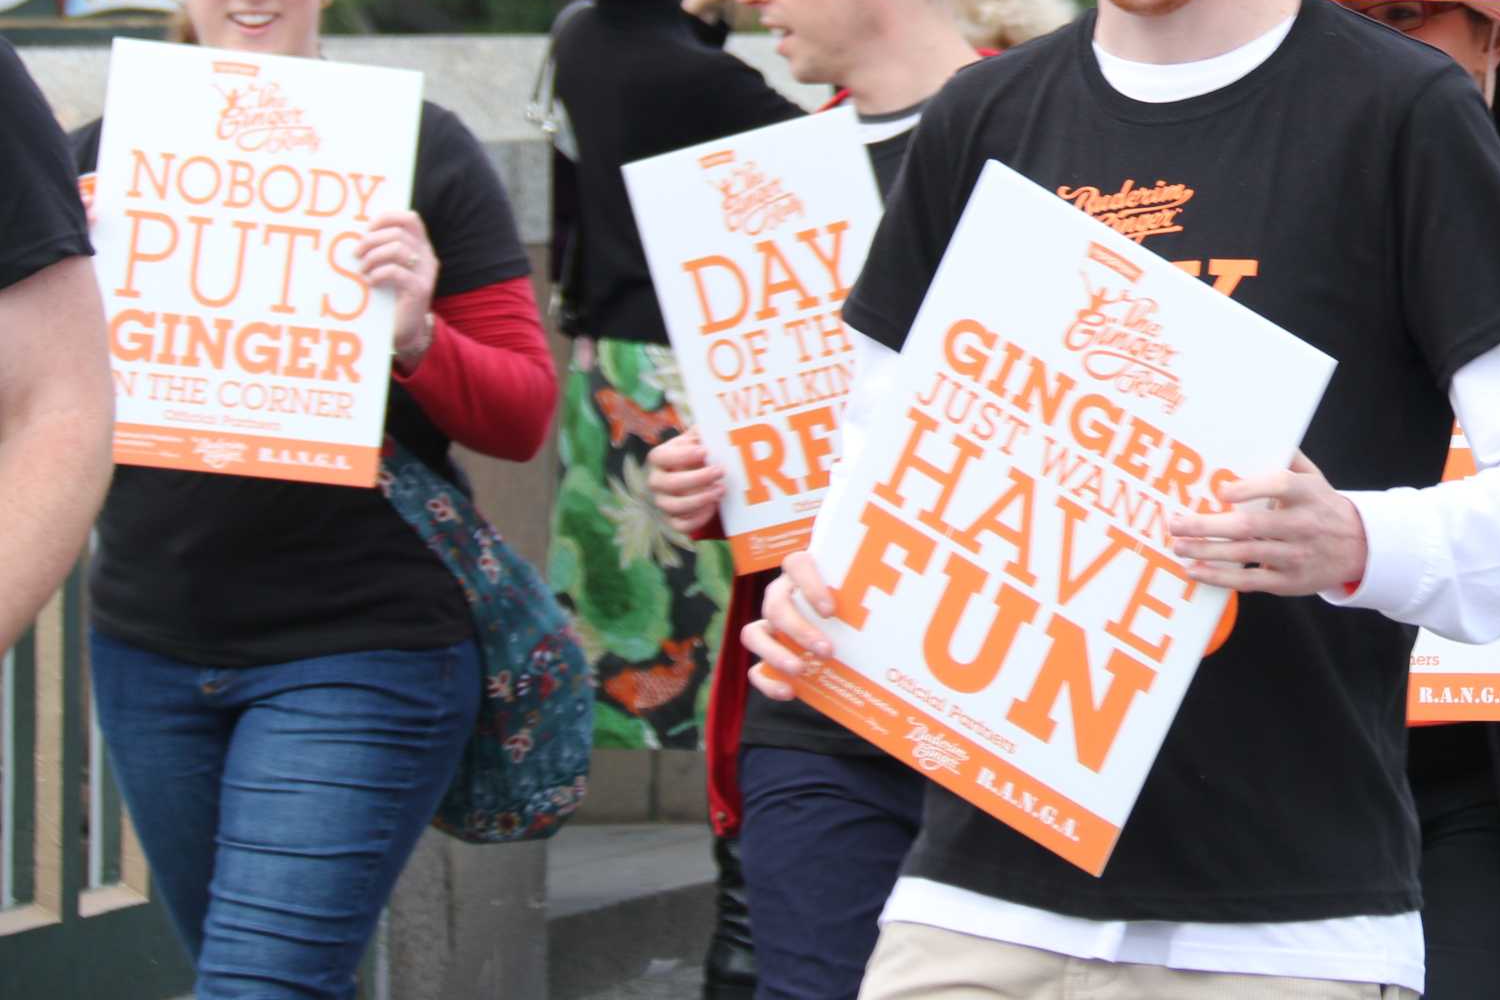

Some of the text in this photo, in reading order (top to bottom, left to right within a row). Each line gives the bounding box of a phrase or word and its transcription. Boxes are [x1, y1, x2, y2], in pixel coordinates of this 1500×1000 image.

[126, 149, 385, 222] NOBODY
[114, 209, 372, 321] PUTS
[682, 220, 852, 336] DAY
[109, 309, 363, 383] GINGER
[706, 311, 854, 382] OF TH
[1063, 318, 1179, 368] Ginger
[113, 370, 353, 420] N THE CORNER
[716, 359, 854, 421] WALKIN
[943, 318, 1242, 514] GINGERS
[728, 406, 838, 505] RE
[916, 372, 1180, 548] JUST WANN
[872, 408, 1197, 664] HAVE
[828, 503, 1157, 774] FUN
[1409, 652, 1440, 666] ners
[975, 767, 1079, 842] R.A.N.G.A.
